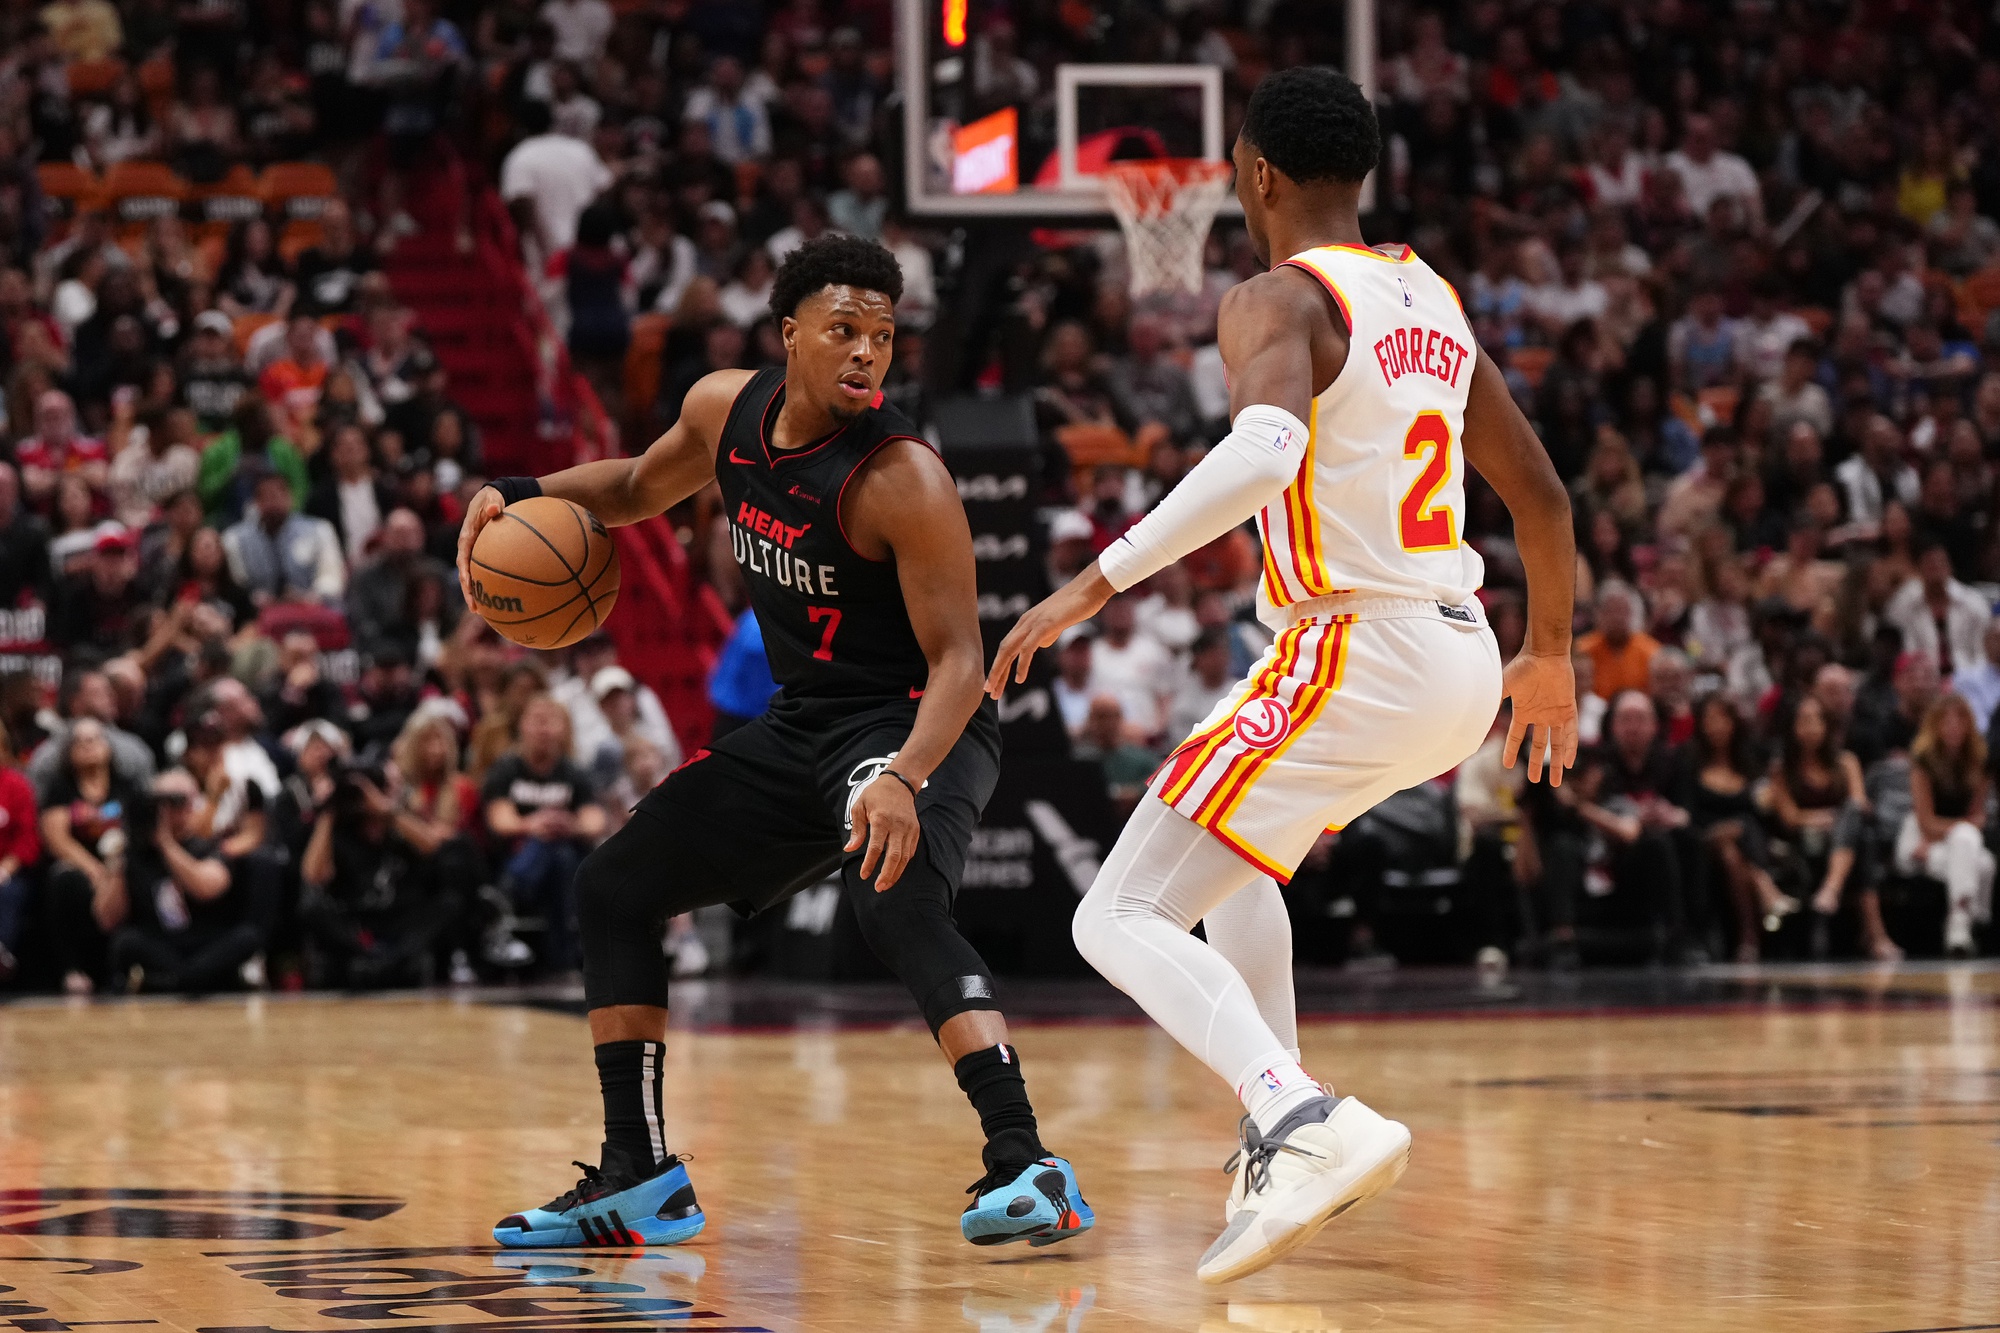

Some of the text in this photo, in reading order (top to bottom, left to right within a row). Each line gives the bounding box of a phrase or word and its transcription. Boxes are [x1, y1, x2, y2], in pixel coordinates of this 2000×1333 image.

[1373, 327, 1469, 389] FORREST
[1398, 409, 1460, 553] 2
[737, 501, 812, 550] HEAT
[726, 516, 839, 596] ULTURE
[472, 579, 524, 613] ilson
[807, 605, 843, 662] 7
